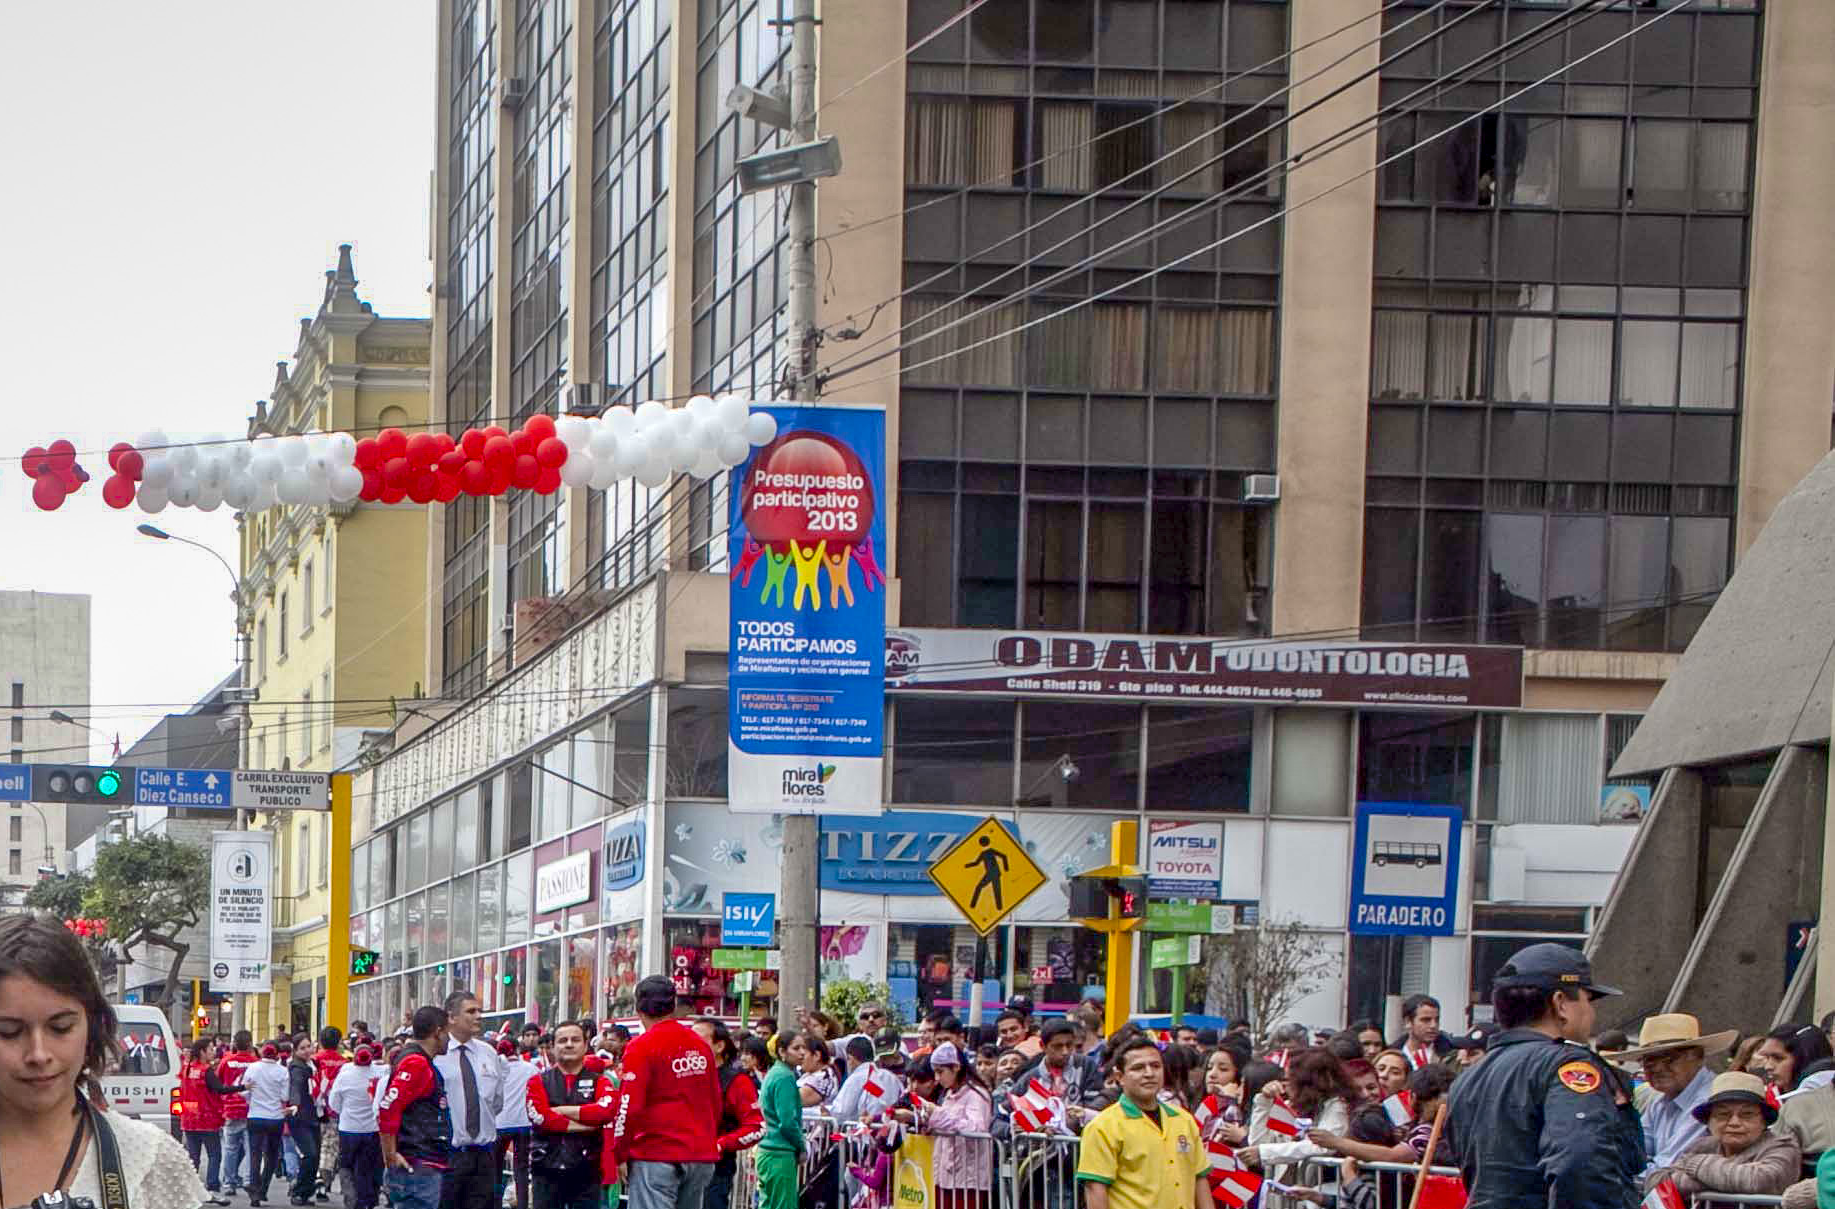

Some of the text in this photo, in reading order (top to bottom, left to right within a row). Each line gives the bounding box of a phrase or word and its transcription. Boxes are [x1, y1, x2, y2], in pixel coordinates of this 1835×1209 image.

[754, 470, 864, 491] Presupuesto
[753, 490, 859, 510] participativo
[807, 511, 858, 531] 2013
[737, 621, 795, 636] TODOS
[737, 637, 857, 654] PARTICIPAMOS
[738, 656, 871, 668] Representantes de organizaciones
[994, 636, 1471, 678] ODAM ODONTOLOGIA
[750, 665, 789, 673] Miraflores
[1145, 682, 1174, 694] piso
[1253, 686, 1270, 697] Fax
[140, 771, 189, 787] Calle E.
[236, 773, 325, 785] CARRIL EXCLUSIVO
[782, 767, 816, 782] mira
[139, 788, 223, 804] Diez Canseco
[249, 785, 311, 795] TRANSPORTE
[782, 781, 825, 796] flores
[821, 829, 962, 863] TIZZ
[1153, 836, 1217, 849] MITSUI
[1156, 862, 1213, 874] TOYOTA
[219, 888, 263, 896] UN MINUTO
[218, 896, 264, 905] DE SILENCIO
[1356, 903, 1447, 928] PARADERO
[103, 1086, 164, 1097] UBISHI
